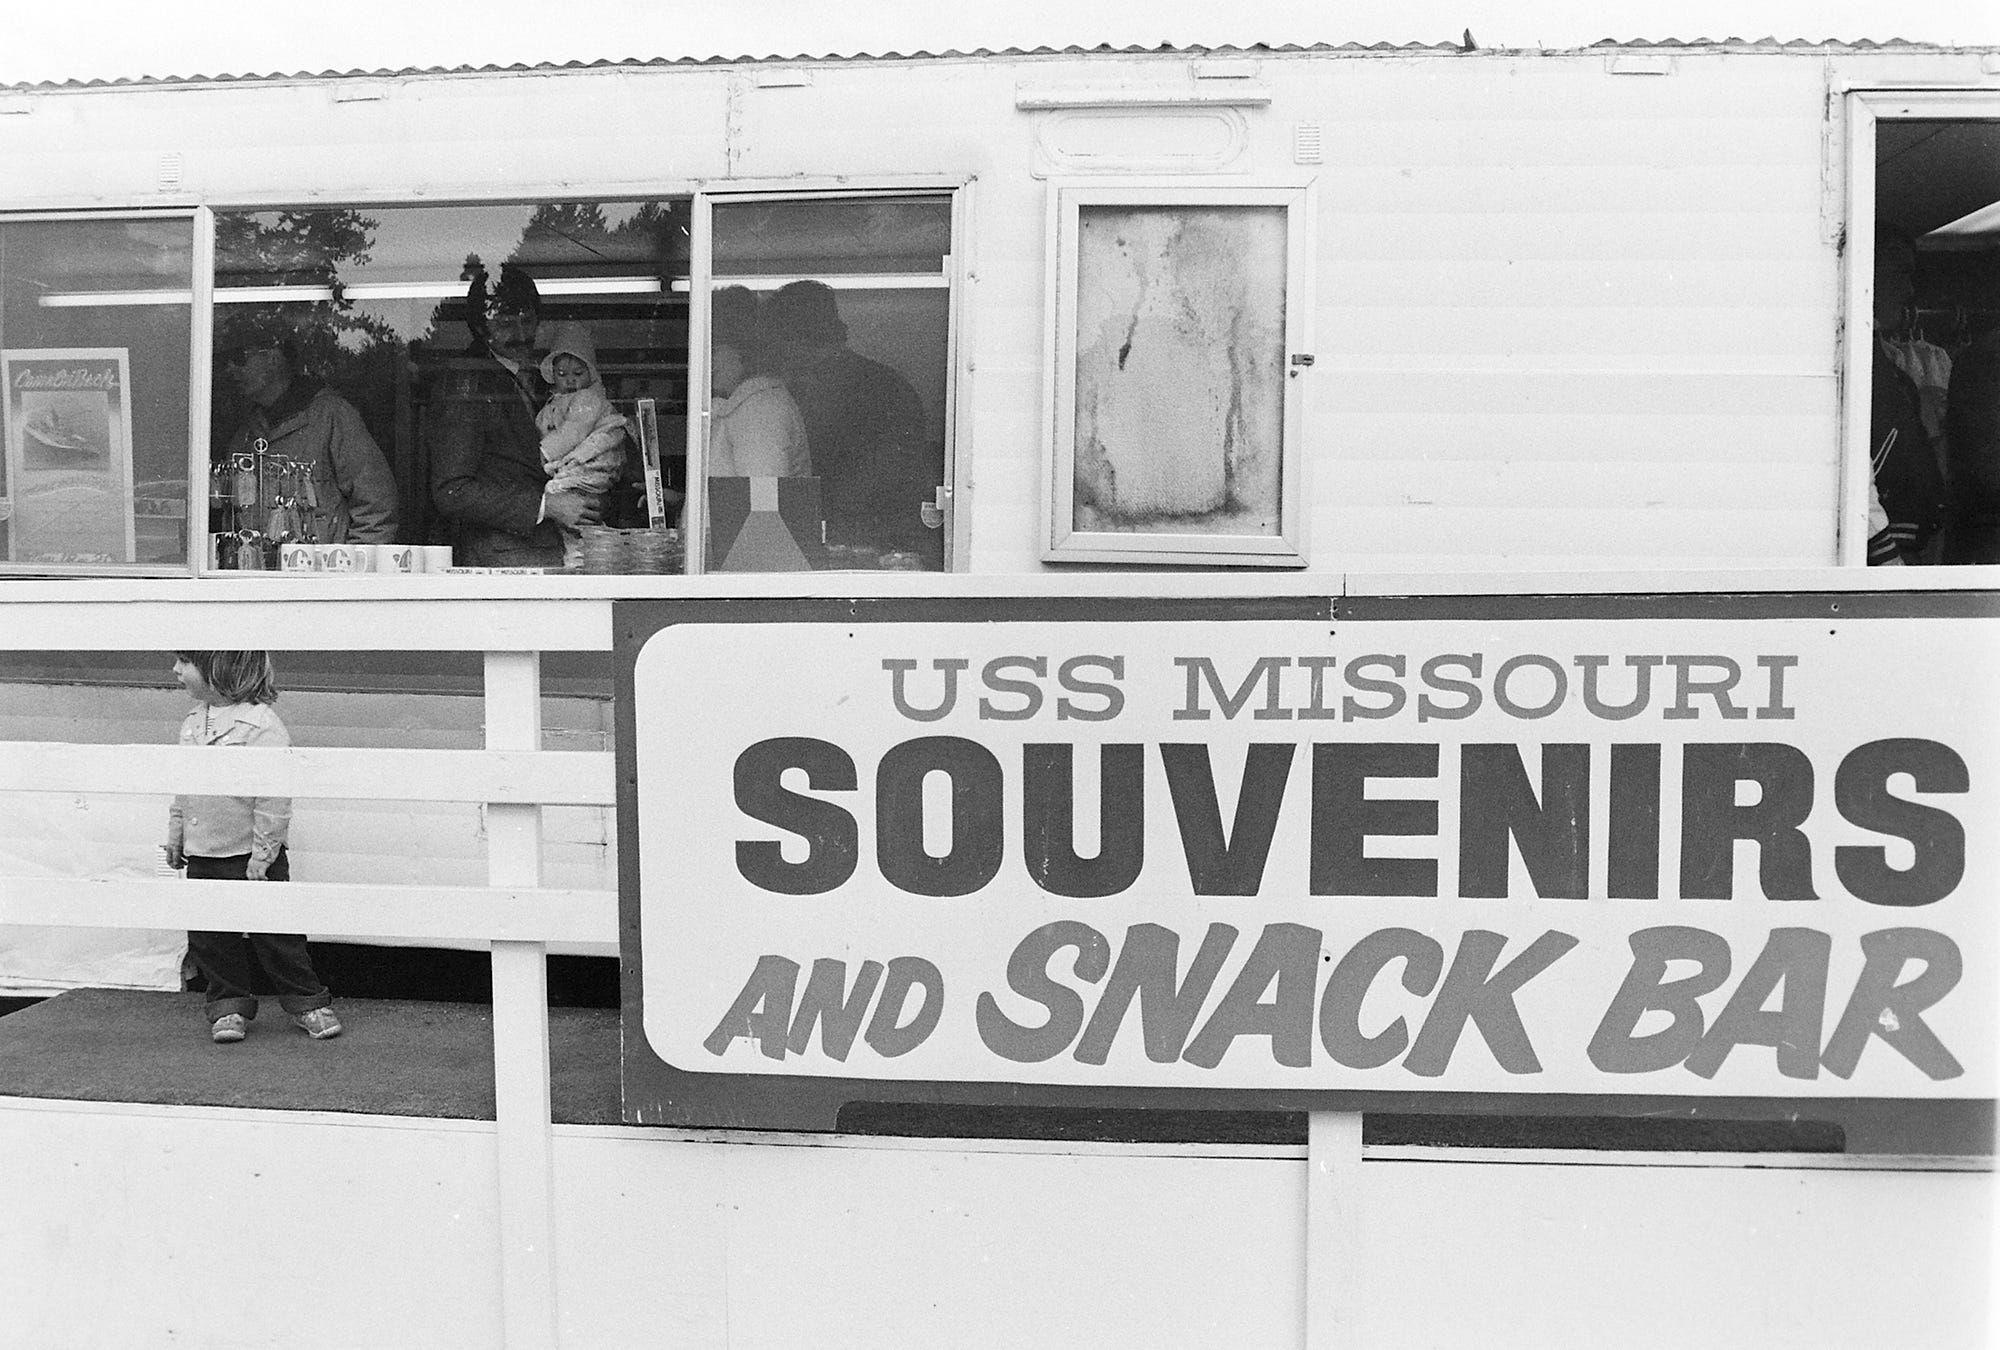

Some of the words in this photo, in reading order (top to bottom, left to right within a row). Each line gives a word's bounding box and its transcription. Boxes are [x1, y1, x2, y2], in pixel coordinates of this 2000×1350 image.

[882, 655, 1126, 723] USS
[1173, 653, 1800, 724] MISSOURI
[733, 736, 1971, 908] SOUVENIRS
[703, 954, 945, 1063] AND
[975, 920, 1581, 1078] SNACK
[1586, 926, 1966, 1082] BAR
